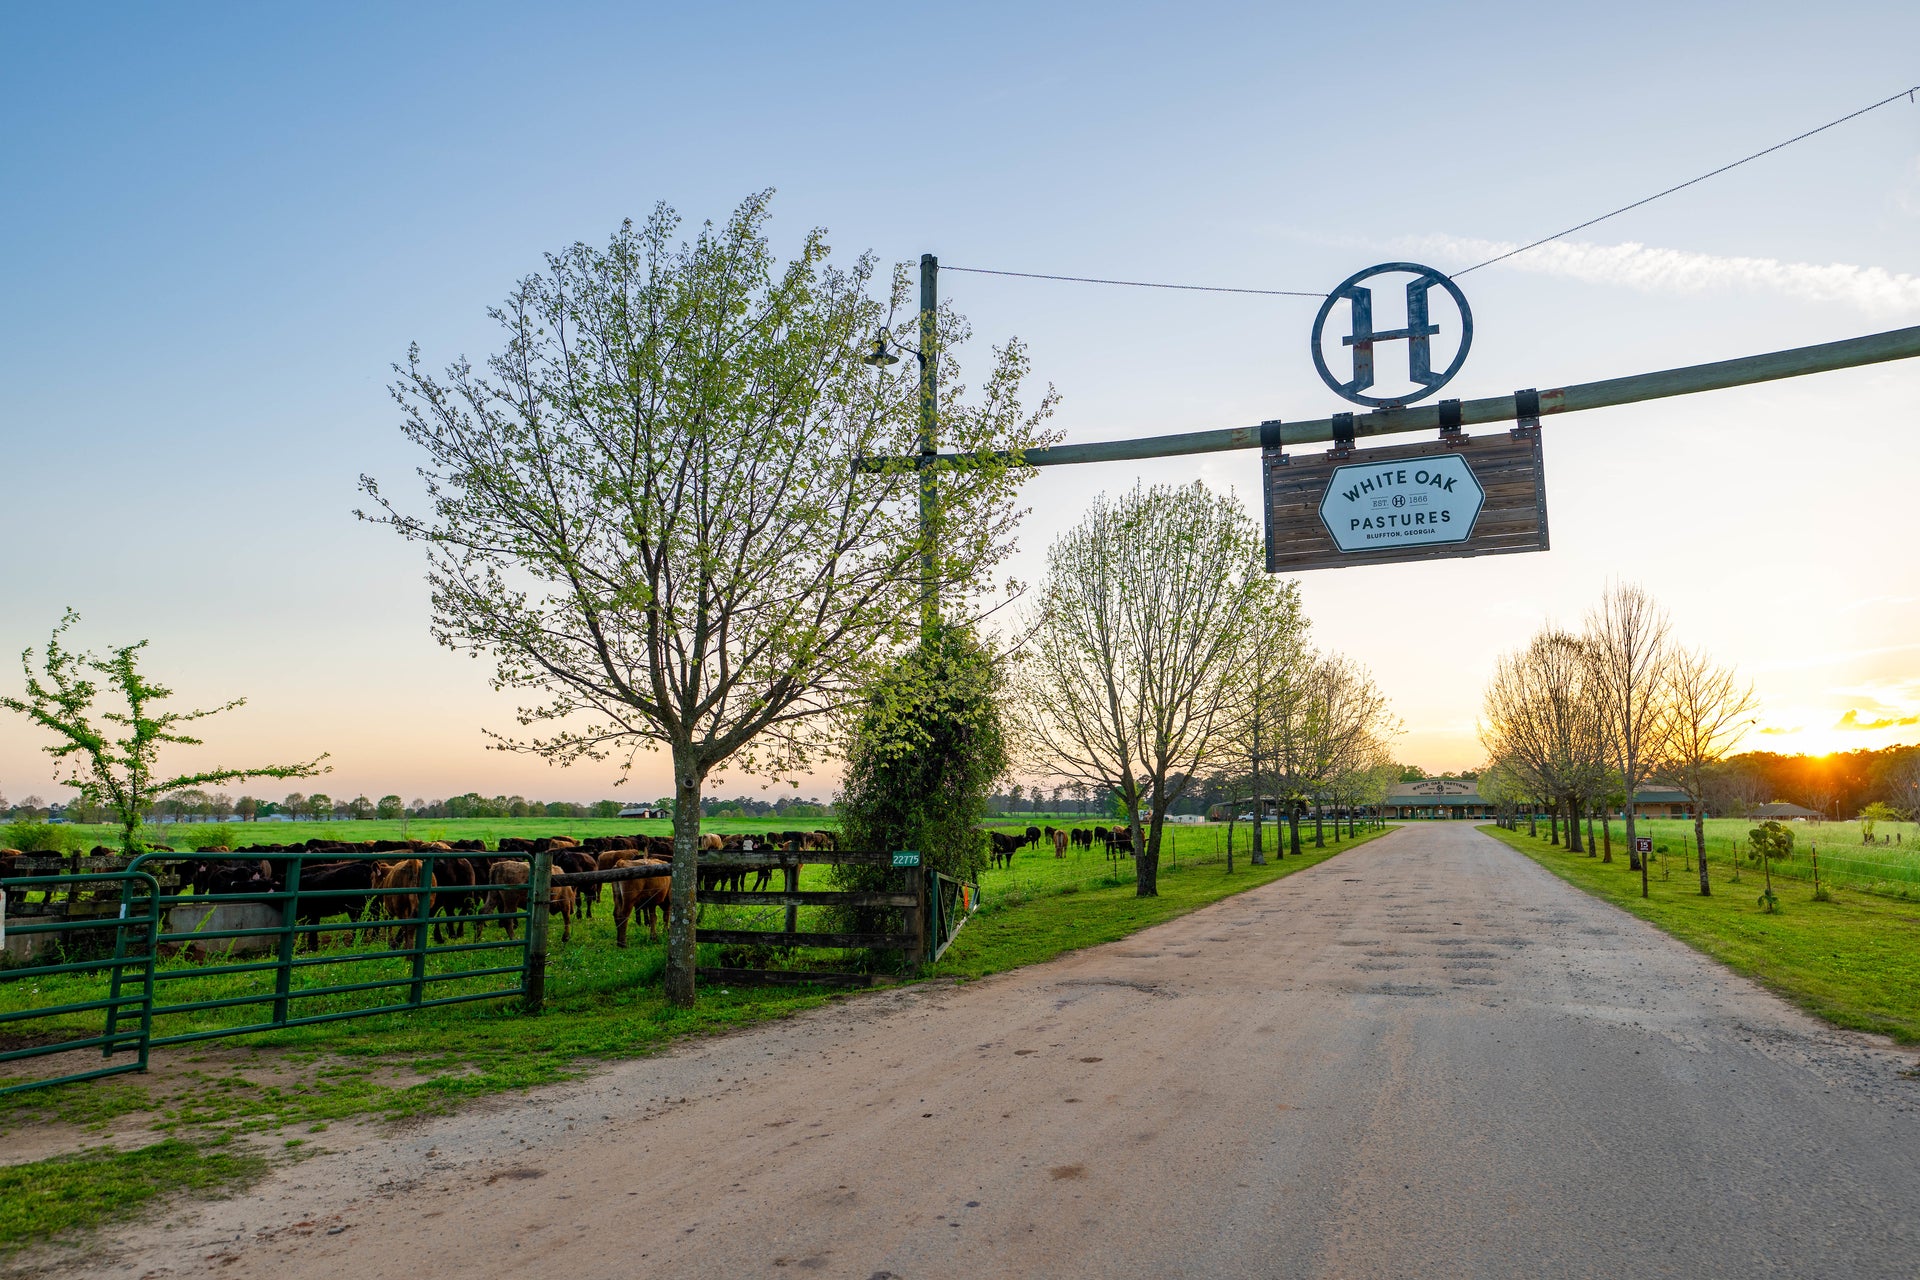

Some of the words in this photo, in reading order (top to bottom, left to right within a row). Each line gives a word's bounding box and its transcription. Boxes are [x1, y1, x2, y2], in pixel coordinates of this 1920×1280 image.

[1342, 470, 1407, 502] WHITE
[1415, 470, 1458, 493] OAK
[1373, 500, 1389, 508] EST.
[1409, 496, 1428, 504] 1866
[1350, 510, 1451, 531] PASTURES
[1366, 531, 1402, 539] BLUFFTON,
[1404, 528, 1436, 536] GEORGIA
[893, 855, 919, 864] 22775
